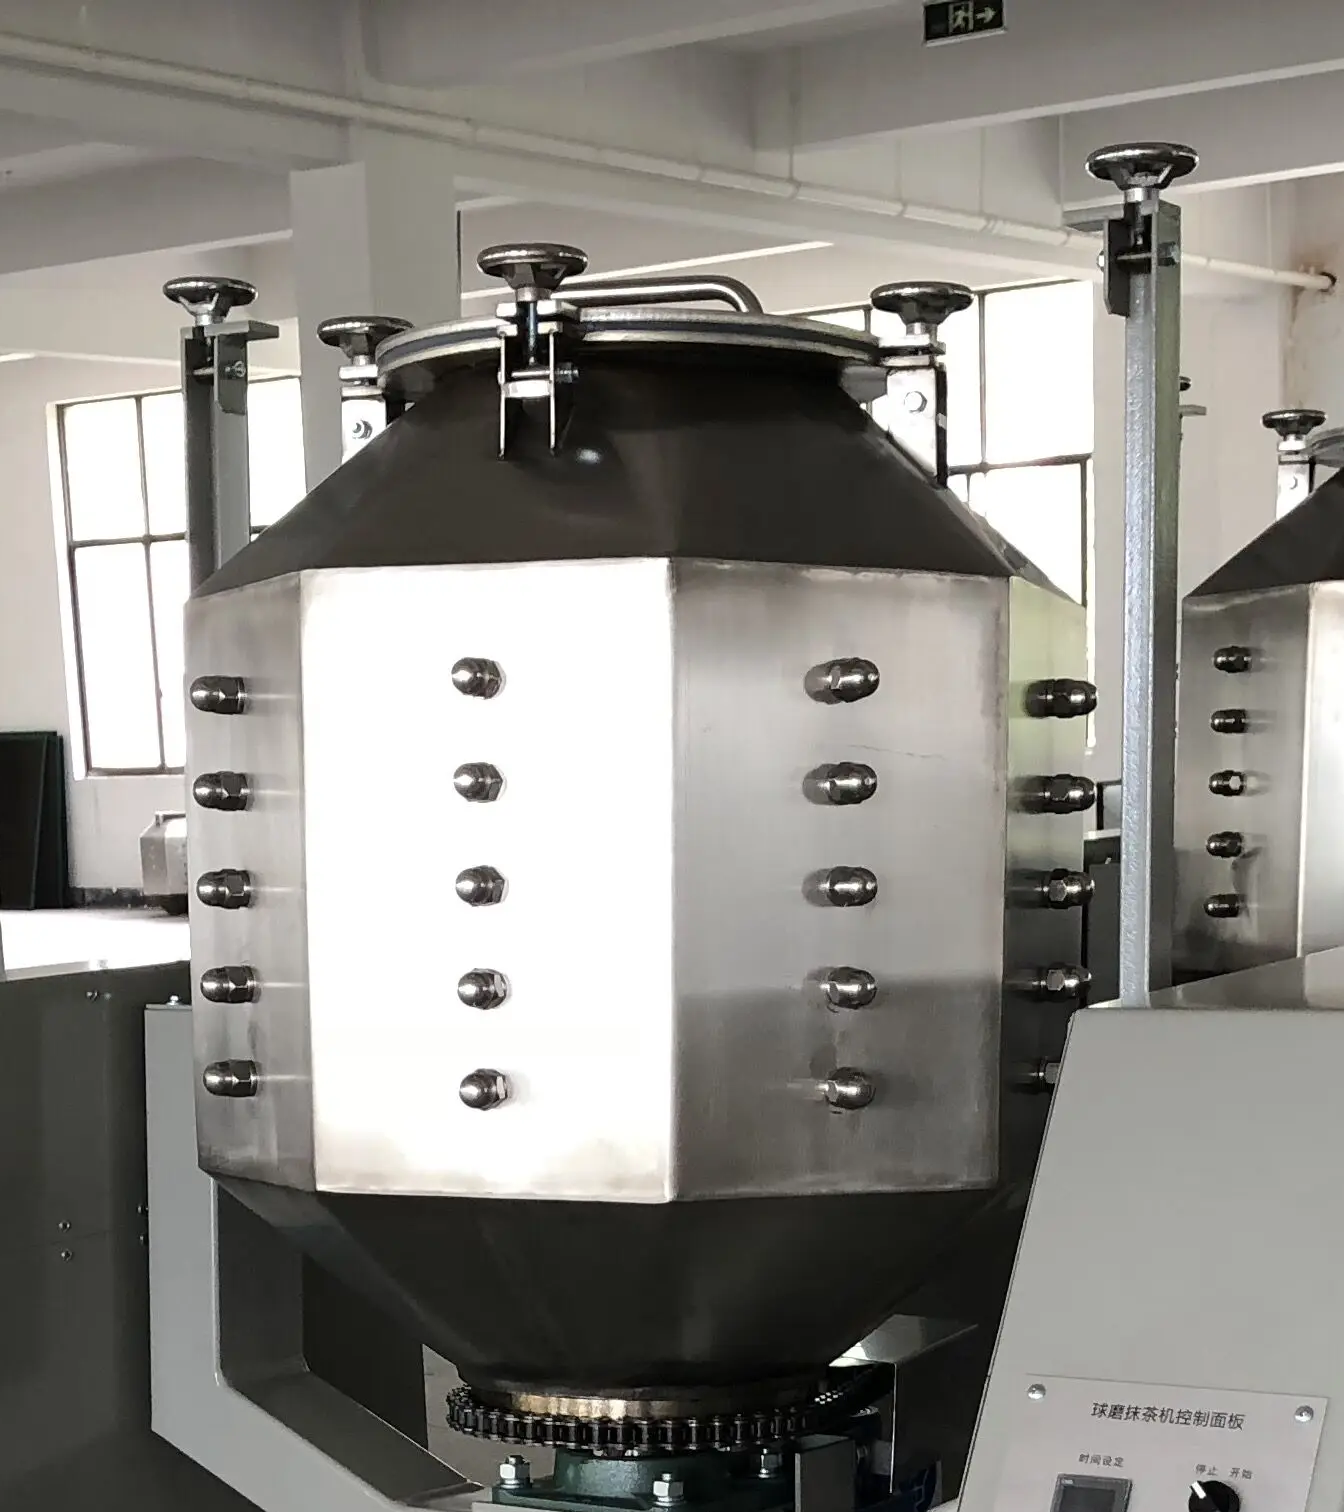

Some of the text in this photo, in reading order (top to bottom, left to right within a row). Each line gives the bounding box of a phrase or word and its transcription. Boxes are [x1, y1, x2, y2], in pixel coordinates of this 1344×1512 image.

[1090, 1402, 1246, 1431] 球磨抹茶机控制面板
[1078, 1453, 1125, 1468] 时间设定
